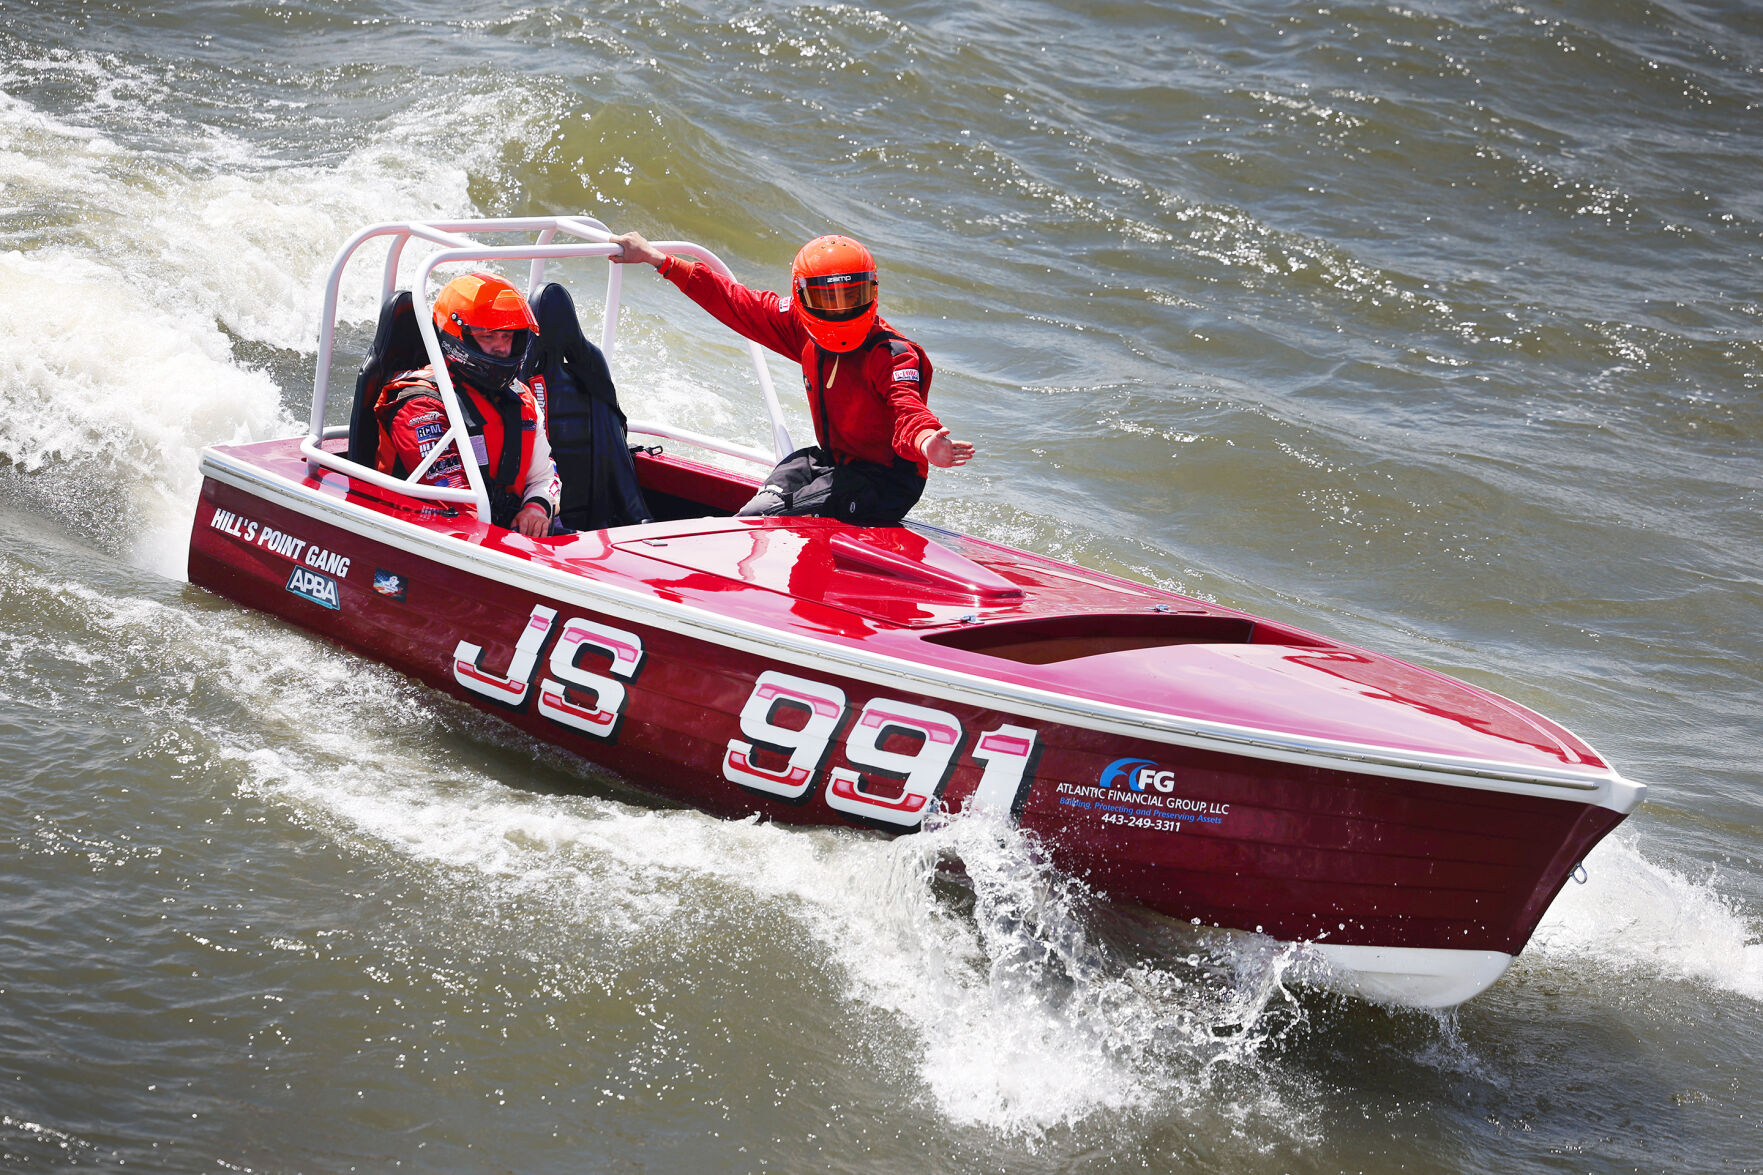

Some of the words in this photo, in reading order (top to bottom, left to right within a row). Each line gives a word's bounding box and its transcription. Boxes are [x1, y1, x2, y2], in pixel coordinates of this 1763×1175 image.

[210, 507, 259, 542] HILL'S
[257, 526, 307, 561] POINT
[304, 545, 351, 579] GANG
[289, 568, 338, 606] APBA
[453, 603, 645, 741] JS
[722, 669, 1041, 829] 991
[1055, 782, 1107, 800] ATLANTIC
[1107, 789, 1164, 807] FINANCIAL
[1166, 797, 1207, 814] GROUP,
[1209, 803, 1230, 815] LLC
[1094, 801, 1134, 815] Protecting
[1135, 806, 1152, 816] and
[1153, 809, 1195, 823] Preserving
[1196, 813, 1222, 824] Assets
[1101, 812, 1181, 832] 443-249-3311
